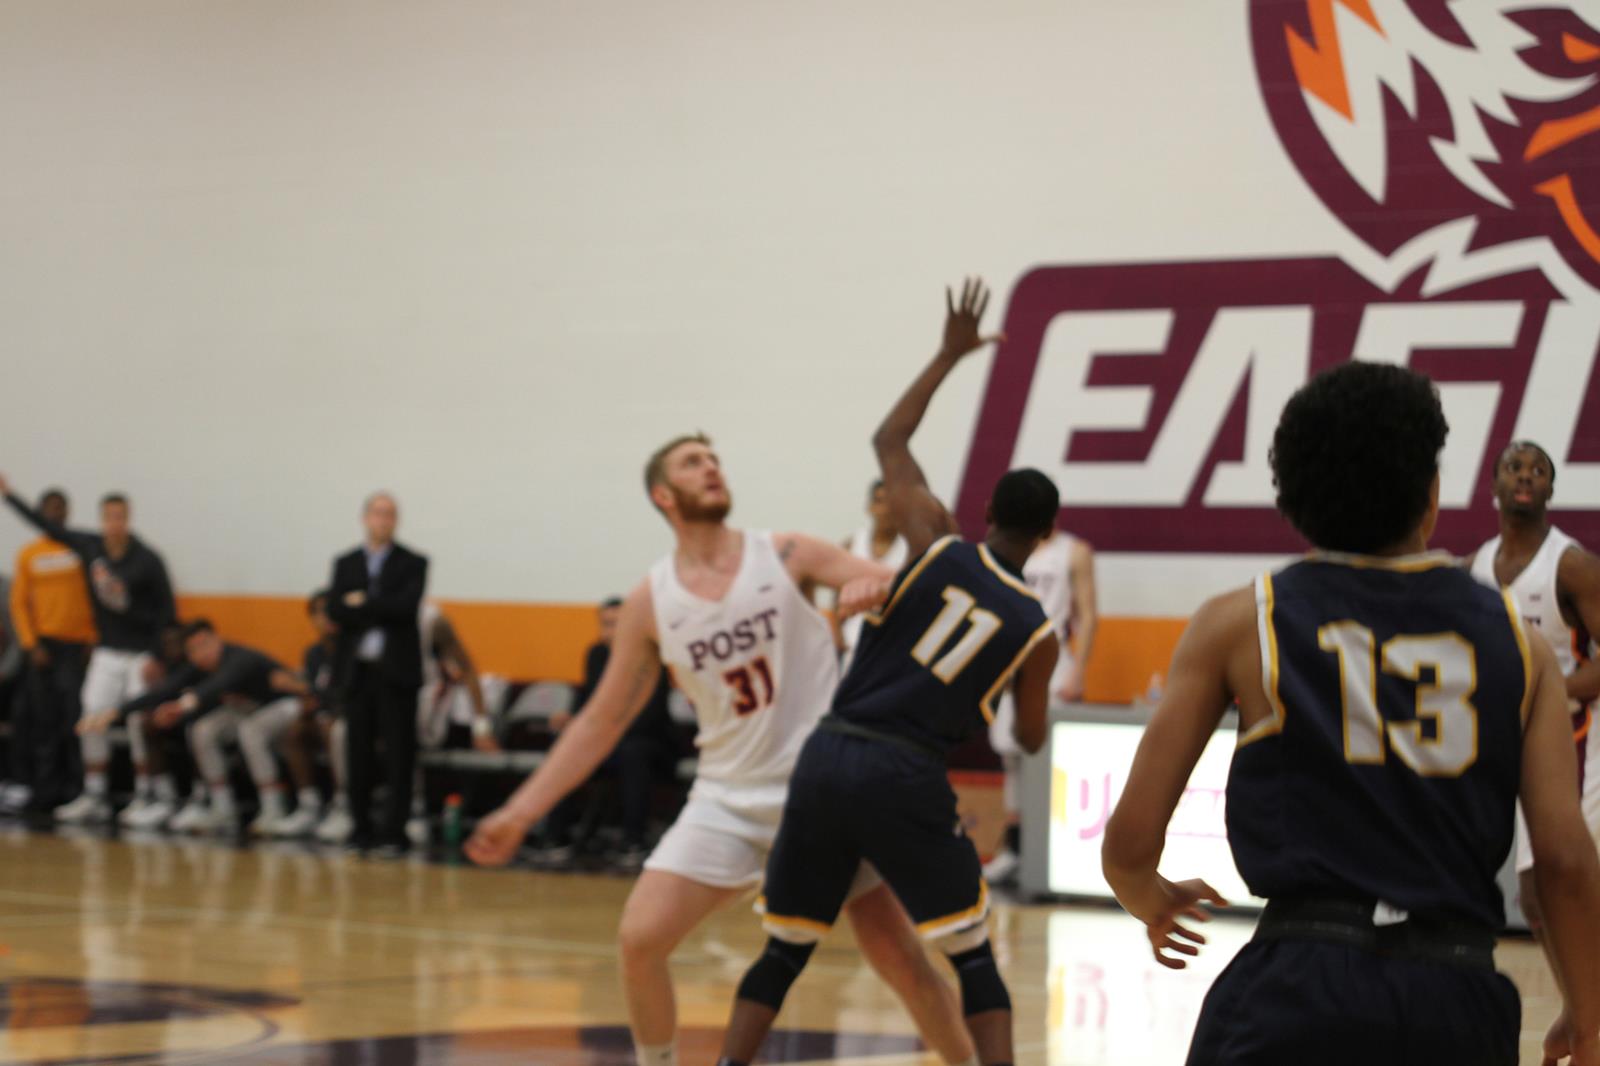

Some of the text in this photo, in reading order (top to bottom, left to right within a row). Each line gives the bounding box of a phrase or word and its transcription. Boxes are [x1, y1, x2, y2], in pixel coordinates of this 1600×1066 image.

[687, 607, 778, 671] POST
[911, 584, 1003, 685] 11
[722, 655, 774, 717] 31
[1317, 618, 1479, 778] 13
